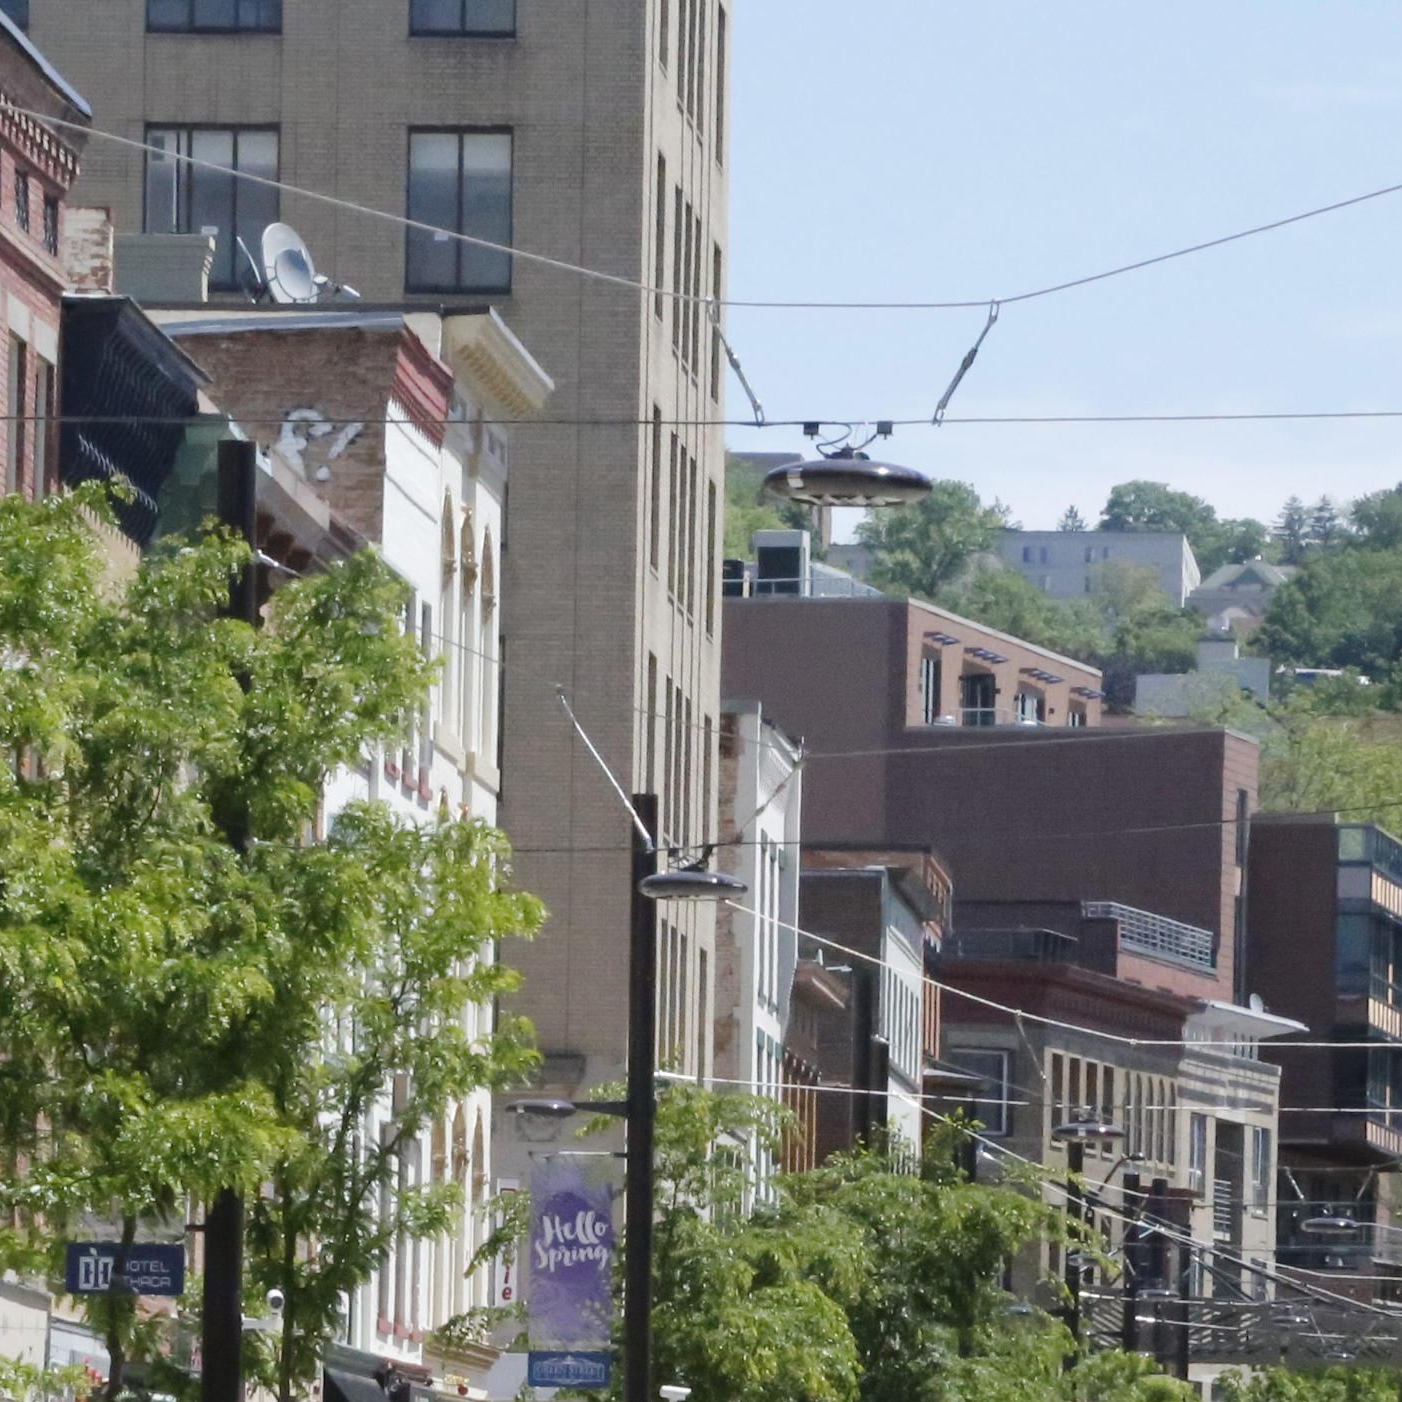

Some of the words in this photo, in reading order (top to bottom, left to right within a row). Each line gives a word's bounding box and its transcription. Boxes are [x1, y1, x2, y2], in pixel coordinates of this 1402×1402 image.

[542, 1211, 608, 1247] Hello
[534, 1240, 611, 1272] Spring
[122, 1275, 171, 1288] THACA
